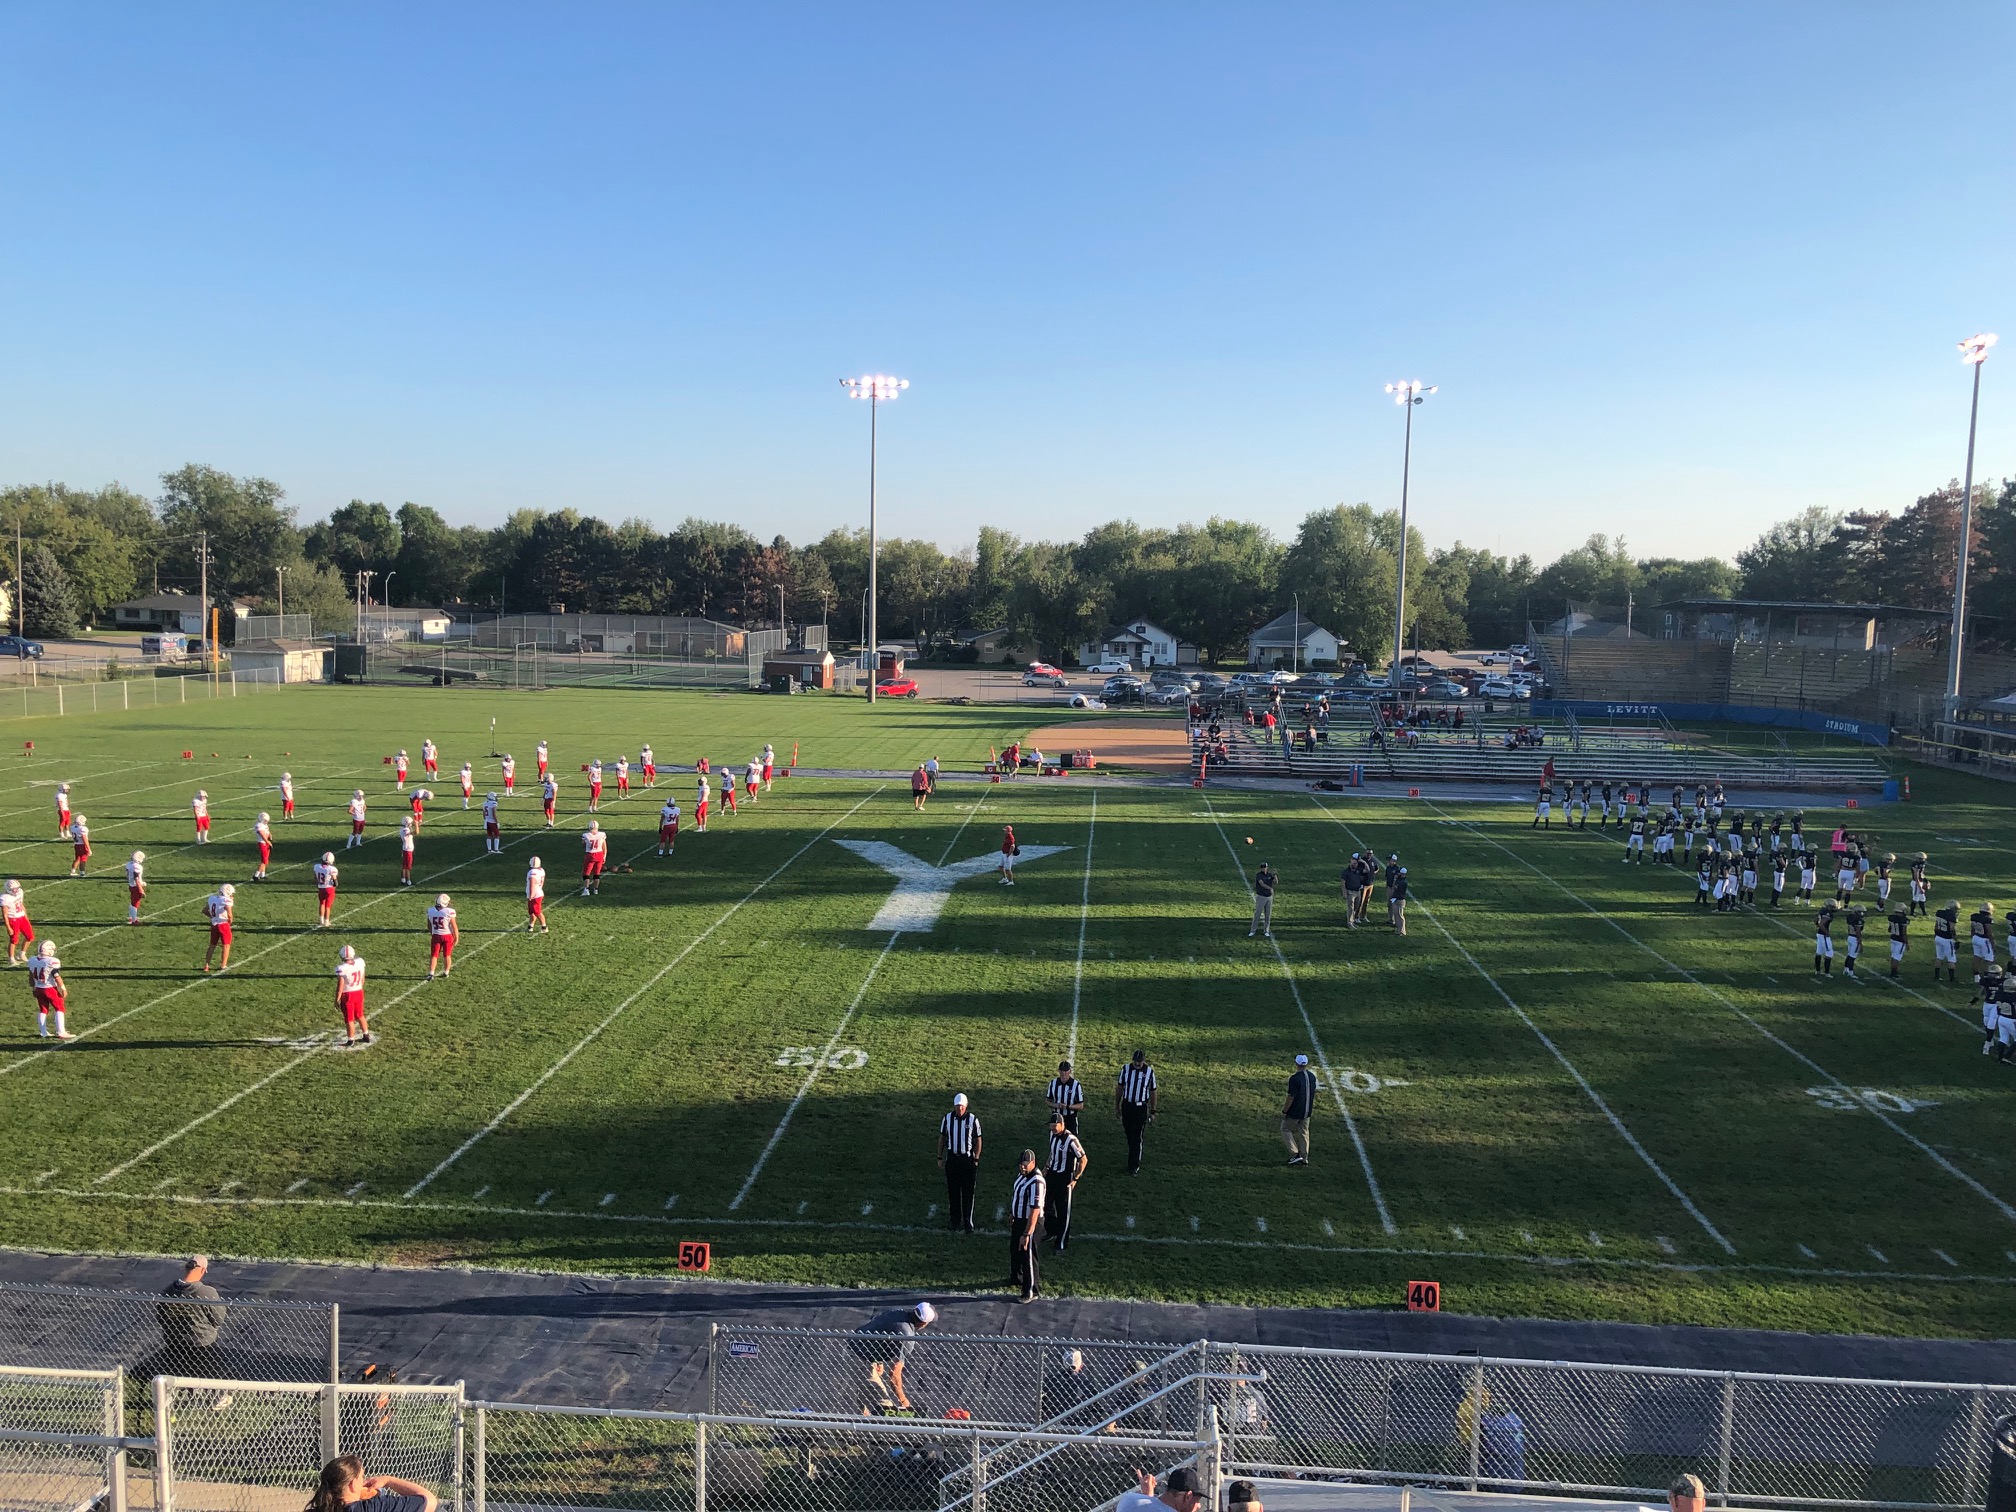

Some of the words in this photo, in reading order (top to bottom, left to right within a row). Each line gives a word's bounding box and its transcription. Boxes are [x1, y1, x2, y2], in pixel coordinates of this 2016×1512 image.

[1607, 705, 1658, 714] LEVITT
[1825, 719, 1860, 734] STADIUM
[183, 751, 193, 759] 10
[588, 839, 599, 851] 74
[831, 839, 1077, 932] Y
[432, 916, 444, 930] 55
[350, 970, 361, 987] 71
[774, 1046, 870, 1070] 50
[1804, 1086, 1915, 1113] 30
[681, 1245, 707, 1268] 50
[1410, 1284, 1437, 1309] 40
[731, 1343, 759, 1354] AMERICAN
